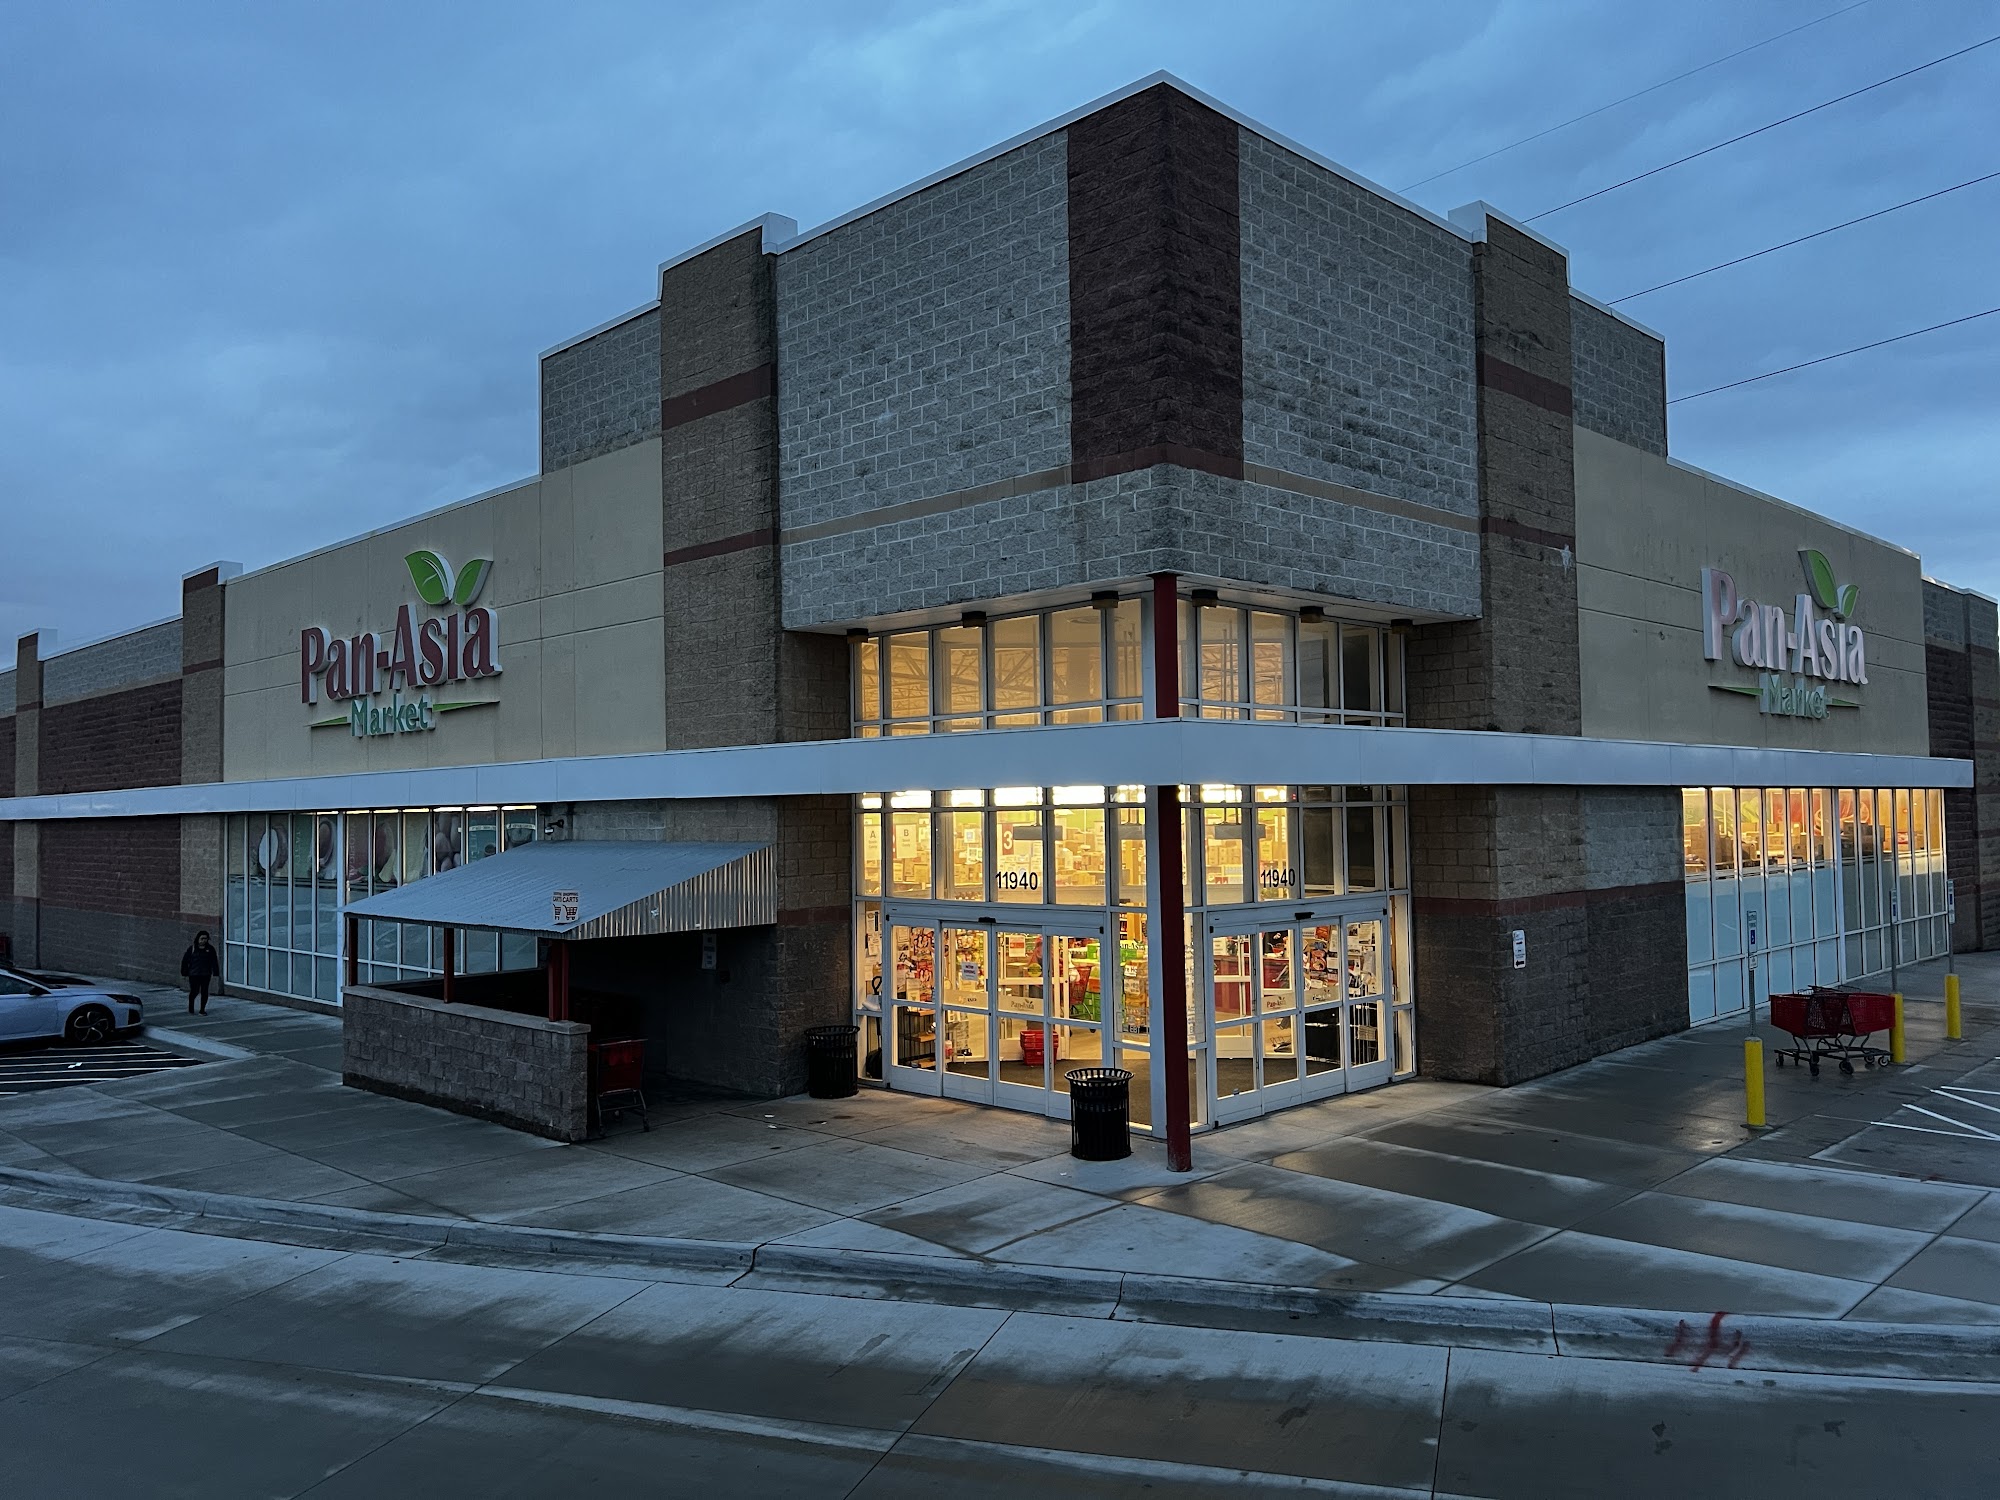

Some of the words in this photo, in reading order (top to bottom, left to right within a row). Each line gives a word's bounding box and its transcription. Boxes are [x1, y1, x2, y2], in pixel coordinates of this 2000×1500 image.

[1702, 568, 1868, 685] Pan-Asia
[301, 603, 502, 704] Pan-Asia
[351, 694, 435, 737] Market
[1759, 673, 1829, 719] Market
[1003, 830, 1013, 850] 3
[995, 871, 1038, 890] 11940
[1260, 868, 1296, 888] 11940
